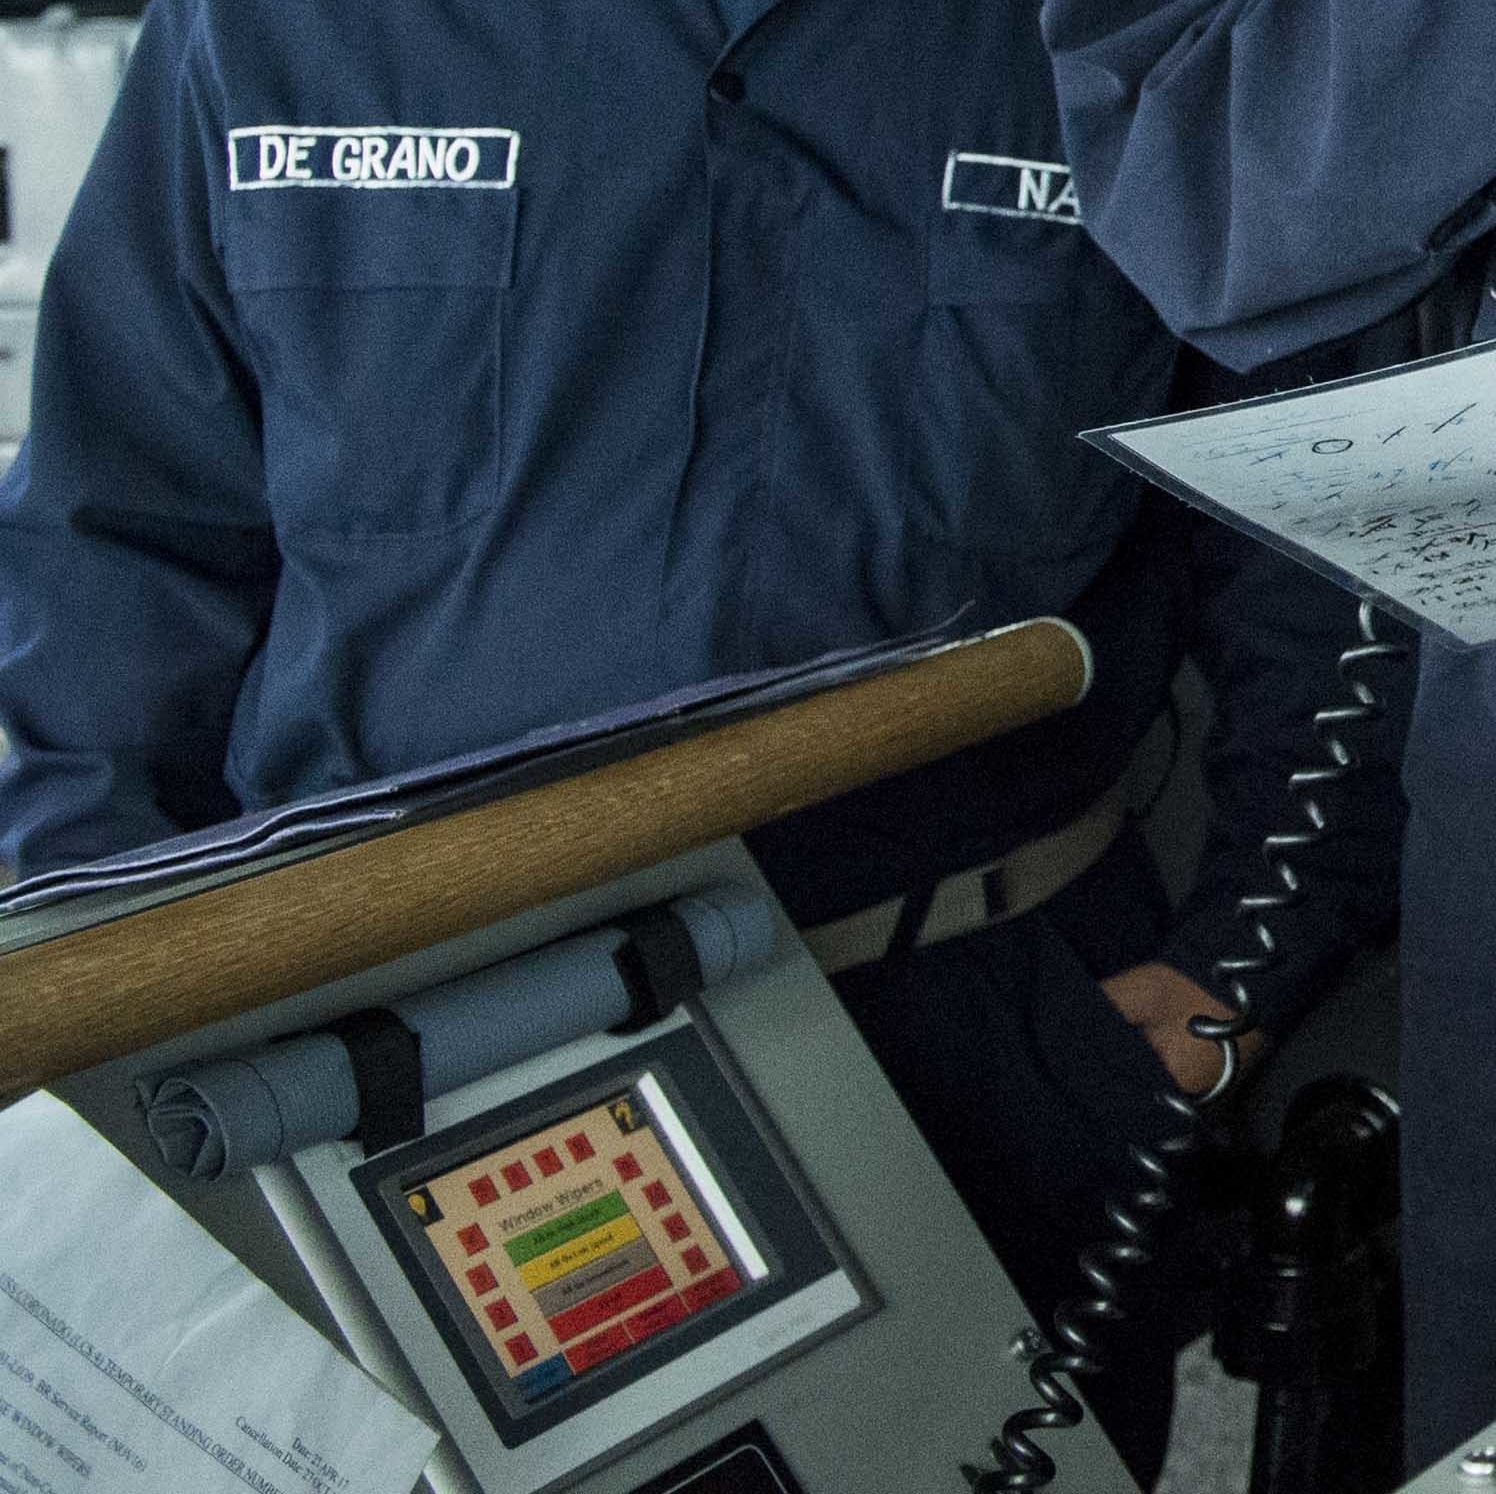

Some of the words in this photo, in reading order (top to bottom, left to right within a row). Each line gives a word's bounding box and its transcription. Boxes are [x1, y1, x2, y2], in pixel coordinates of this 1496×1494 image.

[258, 135, 316, 180] DE
[332, 136, 480, 182] GRANO
[1018, 167, 1082, 216] NA
[499, 1203, 553, 1231] Window
